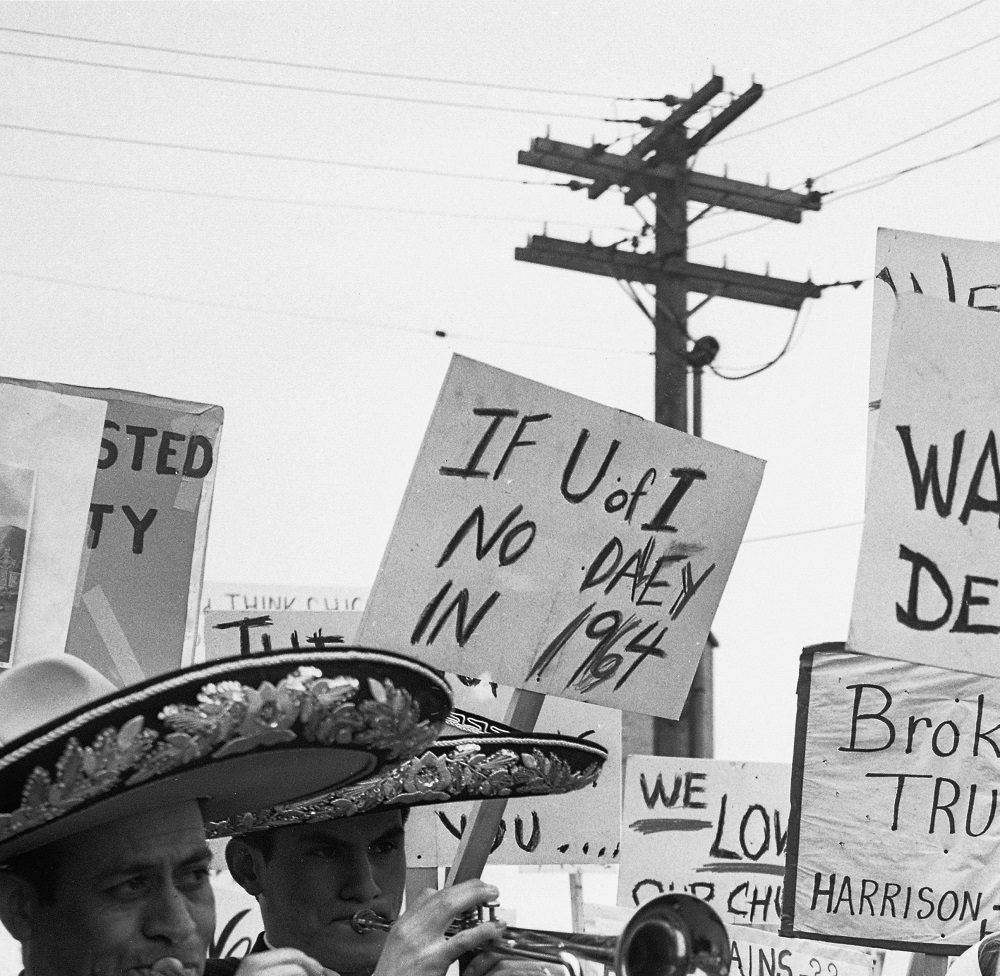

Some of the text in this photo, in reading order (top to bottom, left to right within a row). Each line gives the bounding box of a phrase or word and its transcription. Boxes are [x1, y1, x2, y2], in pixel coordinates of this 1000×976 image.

[439, 408, 707, 533] IF U of I
[435, 504, 716, 621] NO DALEY
[410, 580, 501, 648] IN
[524, 603, 669, 695] 1964
[639, 771, 706, 809] WE
